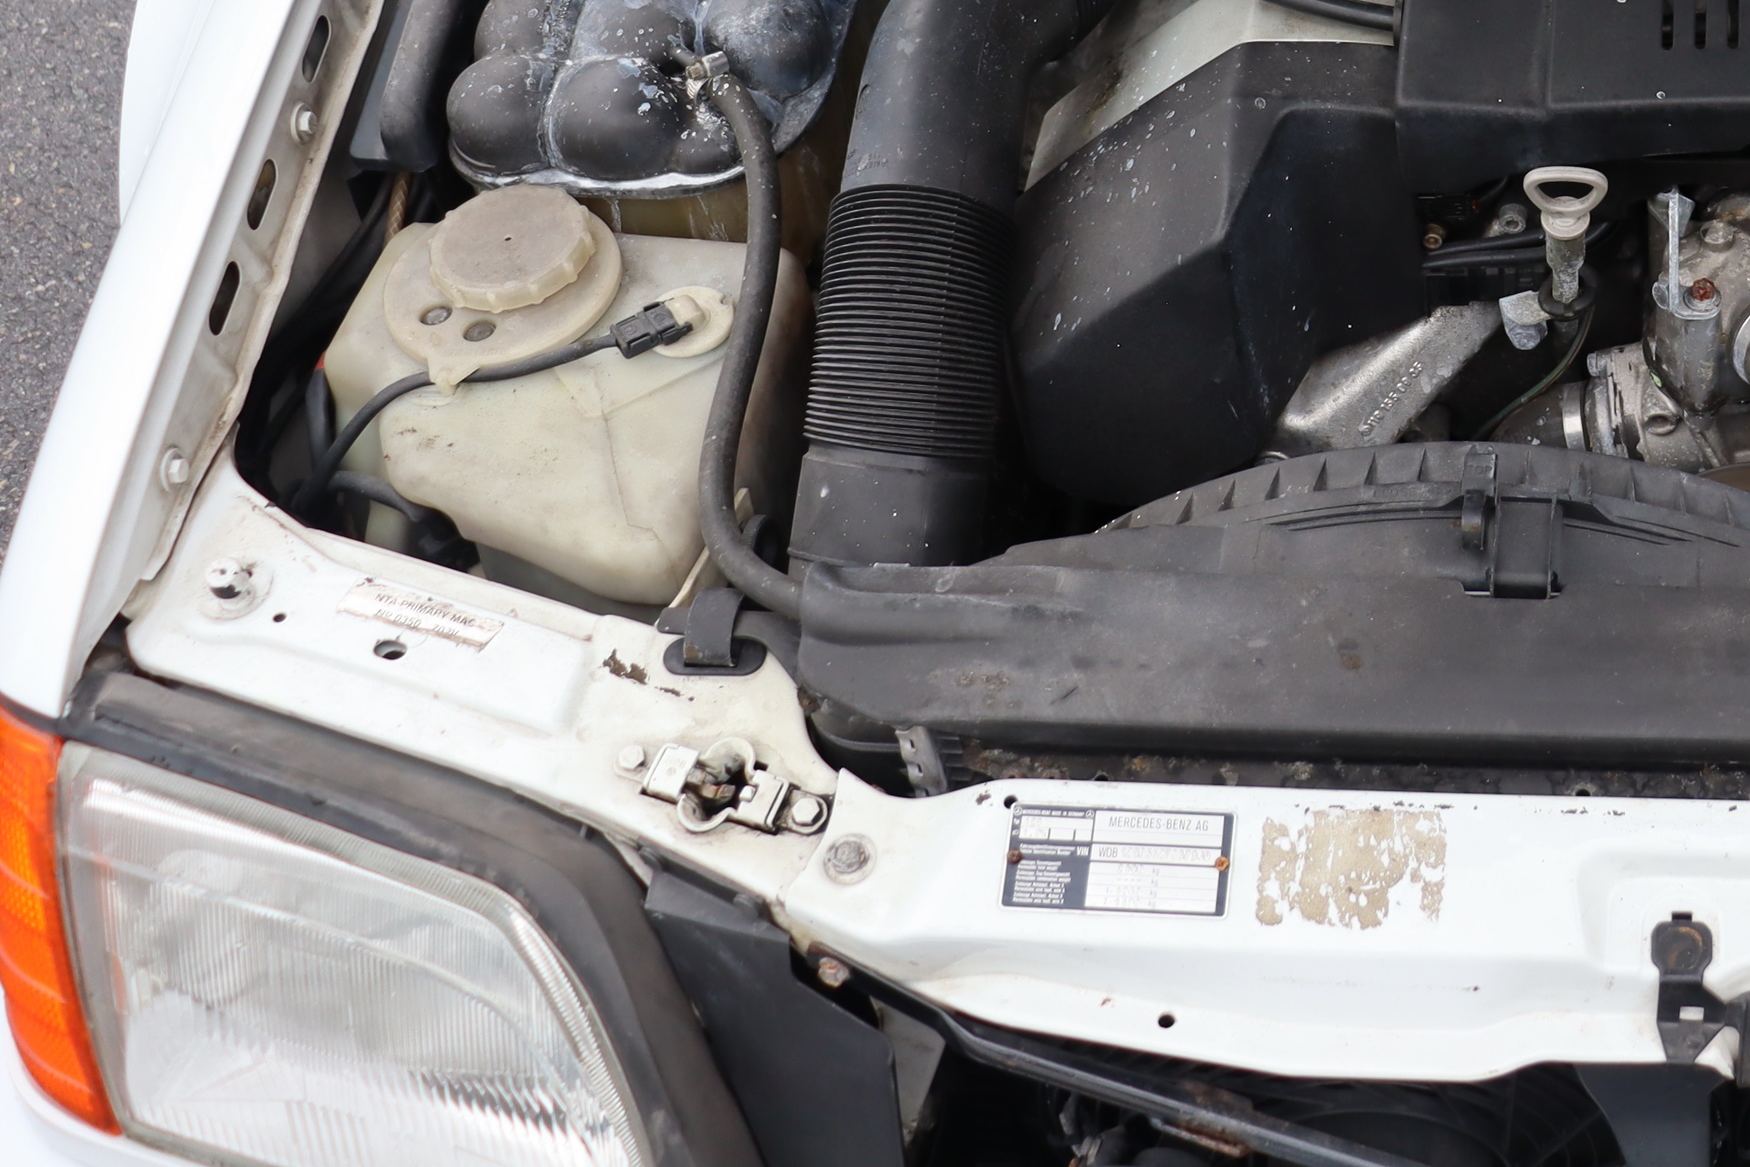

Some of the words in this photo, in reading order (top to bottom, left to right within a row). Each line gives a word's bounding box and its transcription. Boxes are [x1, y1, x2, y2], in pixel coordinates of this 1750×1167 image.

[1109, 816, 1192, 831] MERCEDES-BENZ
[1195, 820, 1209, 831] AG
[1076, 846, 1089, 856] VIN
[1098, 847, 1118, 857] WDB
